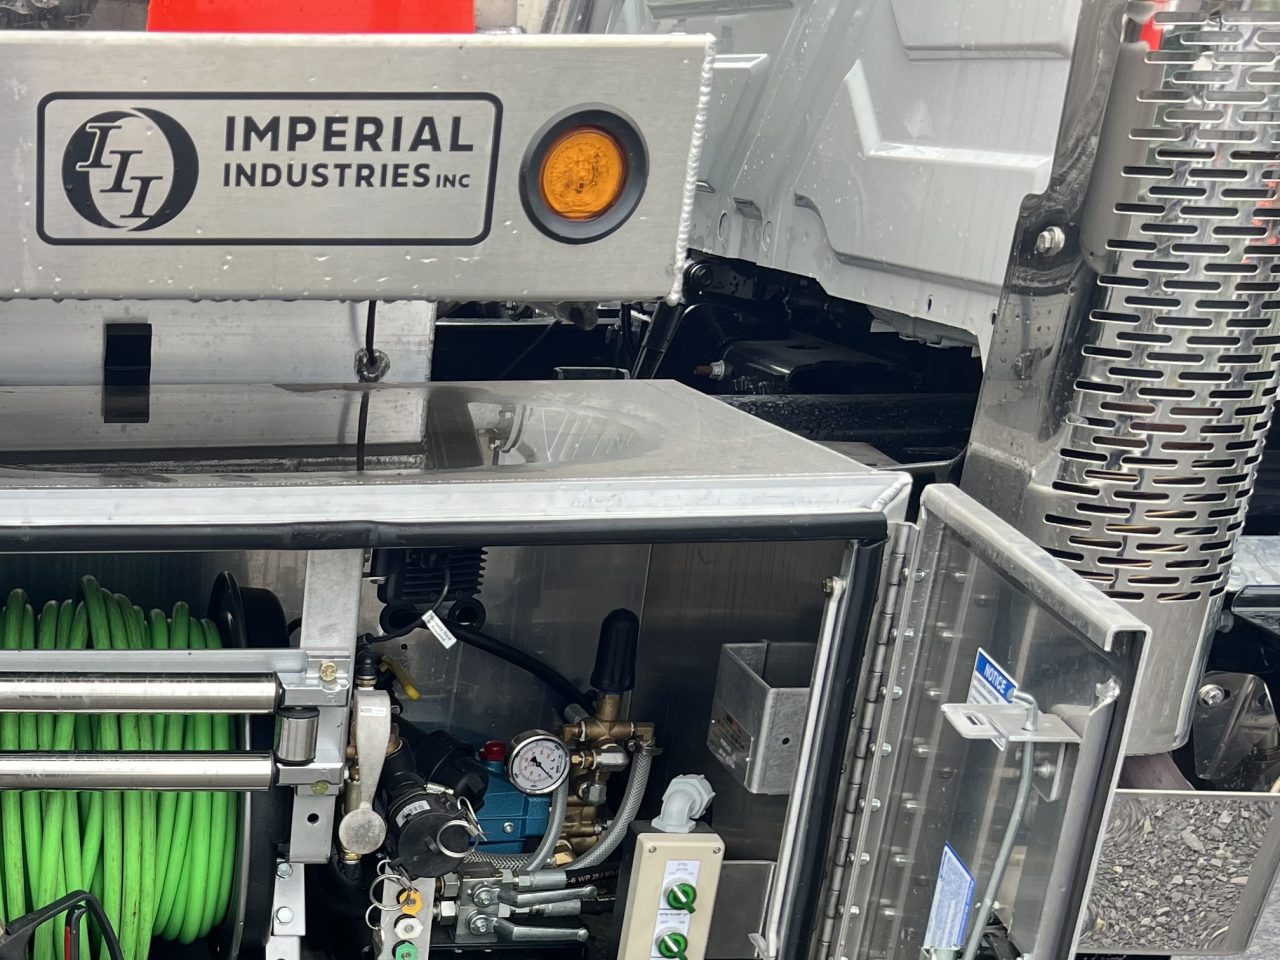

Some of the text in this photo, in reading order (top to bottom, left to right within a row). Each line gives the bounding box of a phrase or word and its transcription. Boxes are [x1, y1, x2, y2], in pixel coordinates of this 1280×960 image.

[224, 115, 475, 153] IMPERIAL
[222, 162, 472, 189] INDUSTRIES INC
[982, 662, 1008, 695] NOTICE
